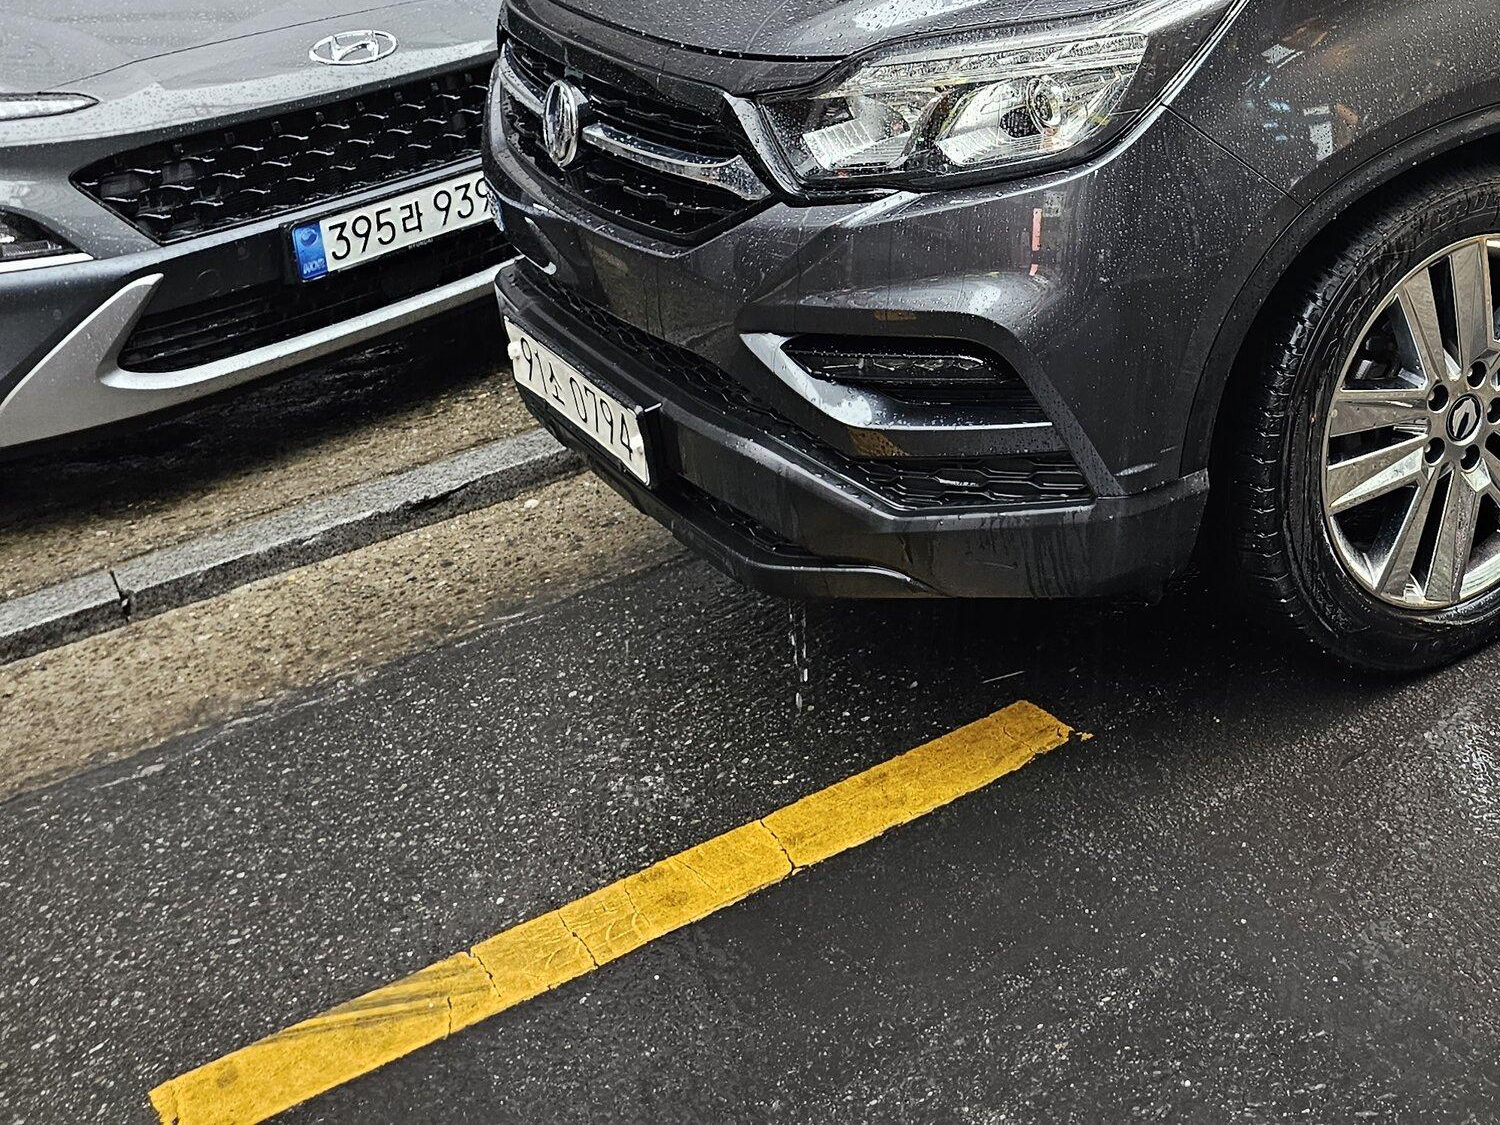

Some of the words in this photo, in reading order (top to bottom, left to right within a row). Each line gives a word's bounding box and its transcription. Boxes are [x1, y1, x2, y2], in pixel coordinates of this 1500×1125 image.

[328, 201, 423, 261] 395라
[520, 336, 566, 407] 91소
[569, 376, 634, 462] 0794
